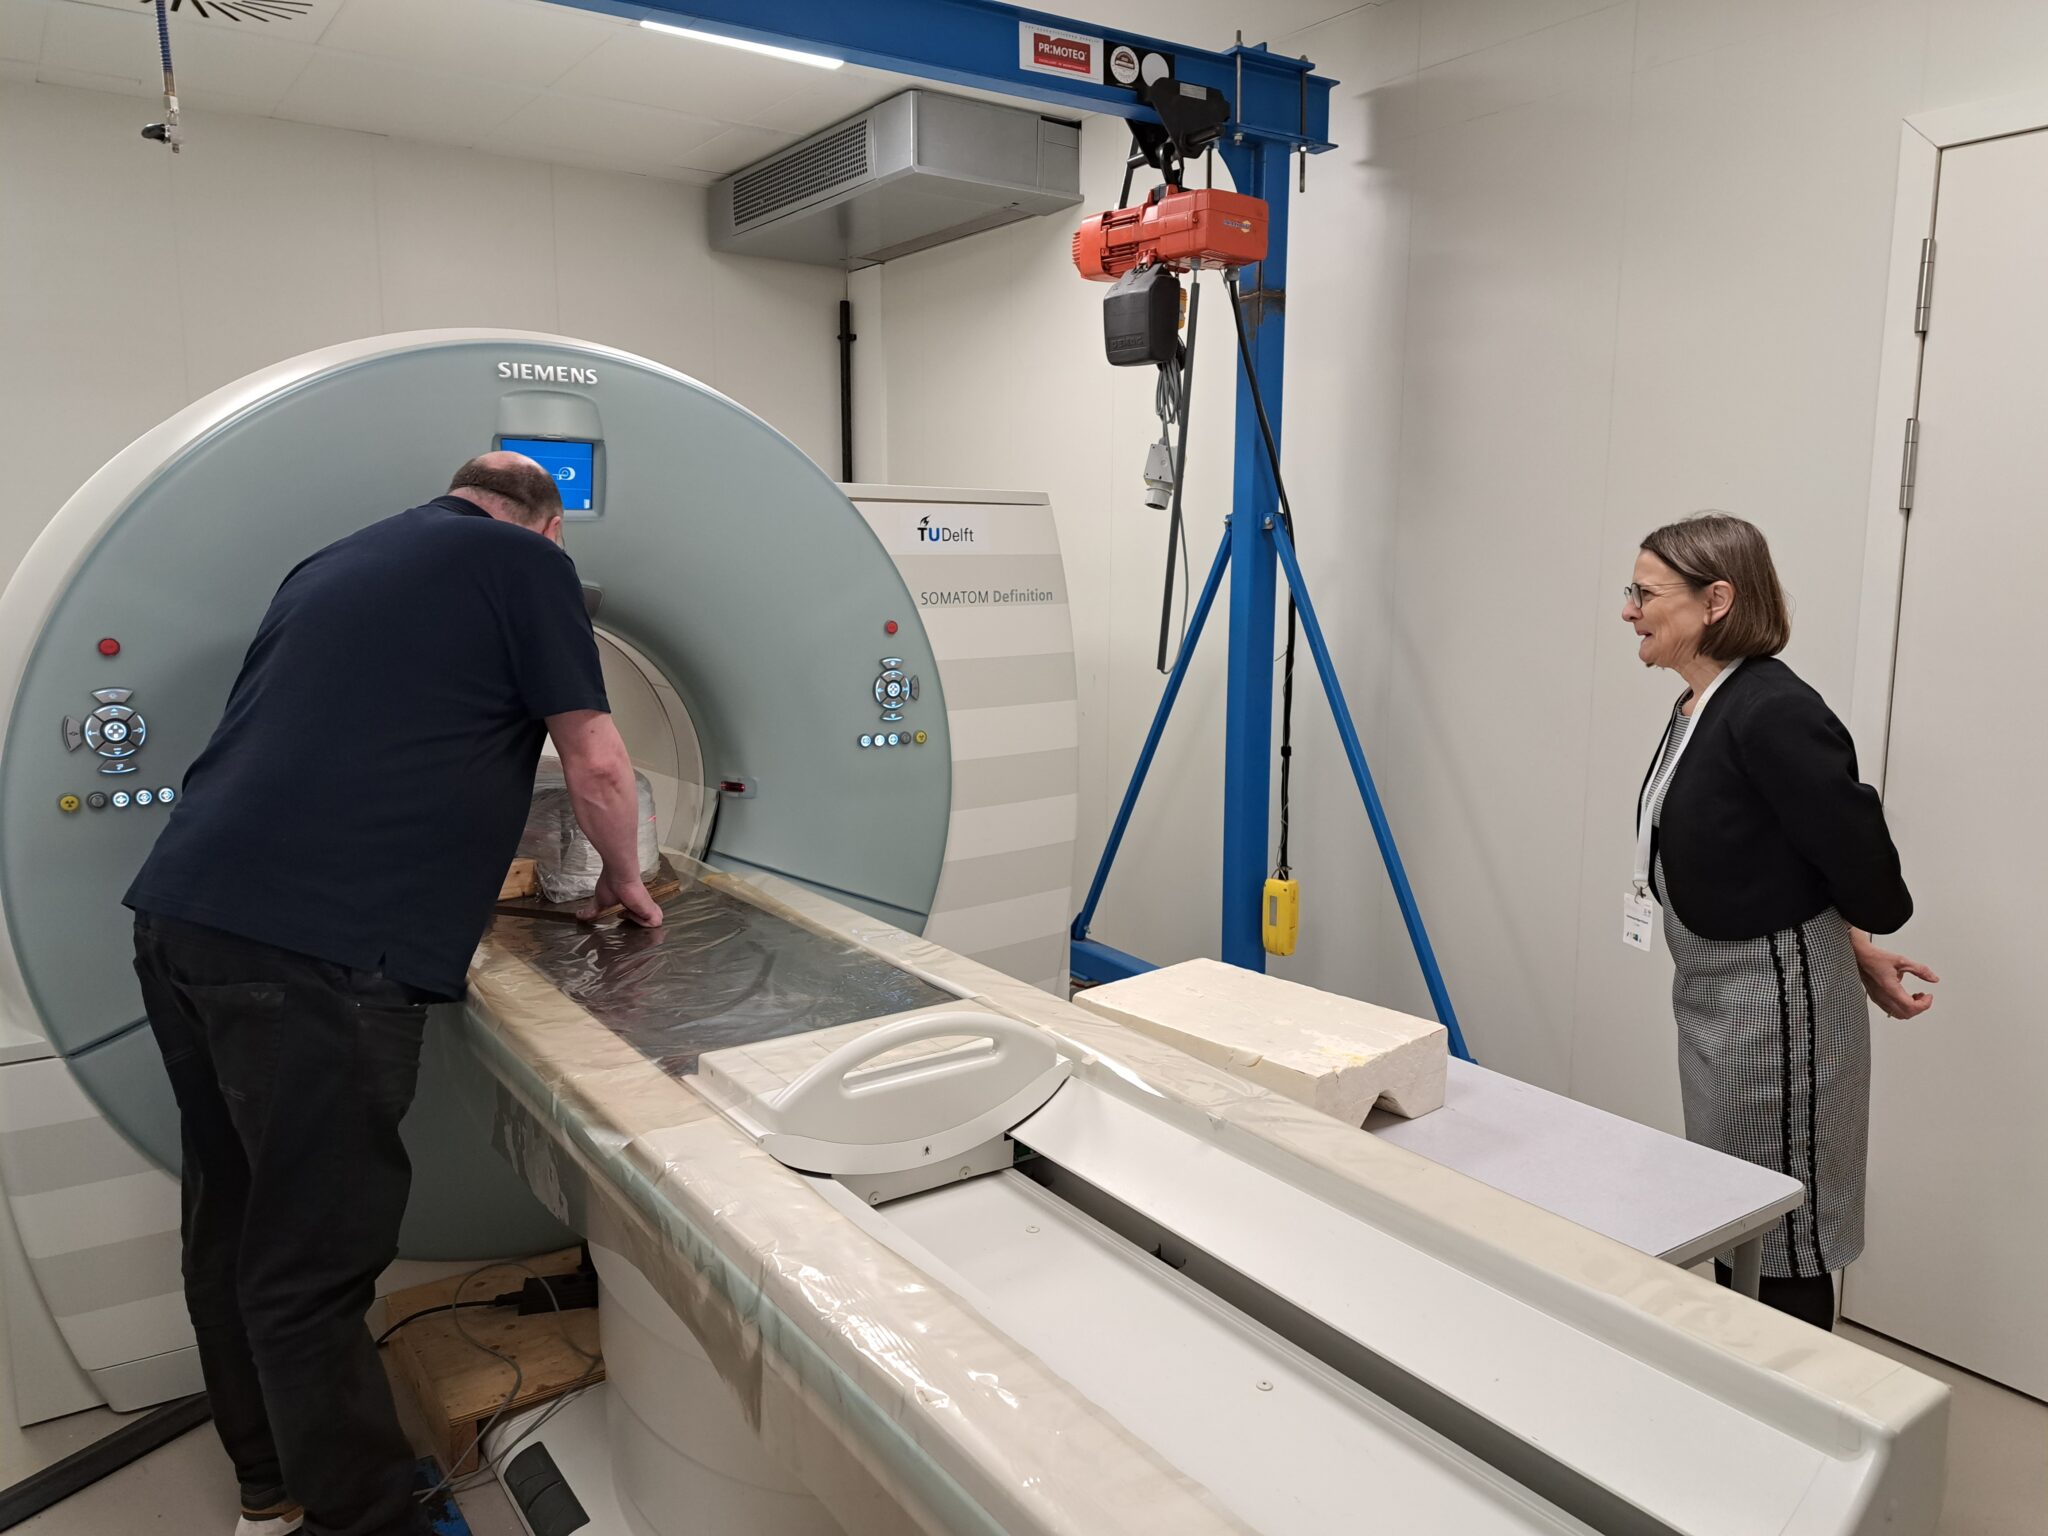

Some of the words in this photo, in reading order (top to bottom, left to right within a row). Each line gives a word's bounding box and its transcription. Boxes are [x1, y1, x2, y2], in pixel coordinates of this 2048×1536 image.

[497, 361, 599, 385] SIEMENS
[920, 590, 989, 606] SOMATOM
[992, 588, 1054, 604] Definition
